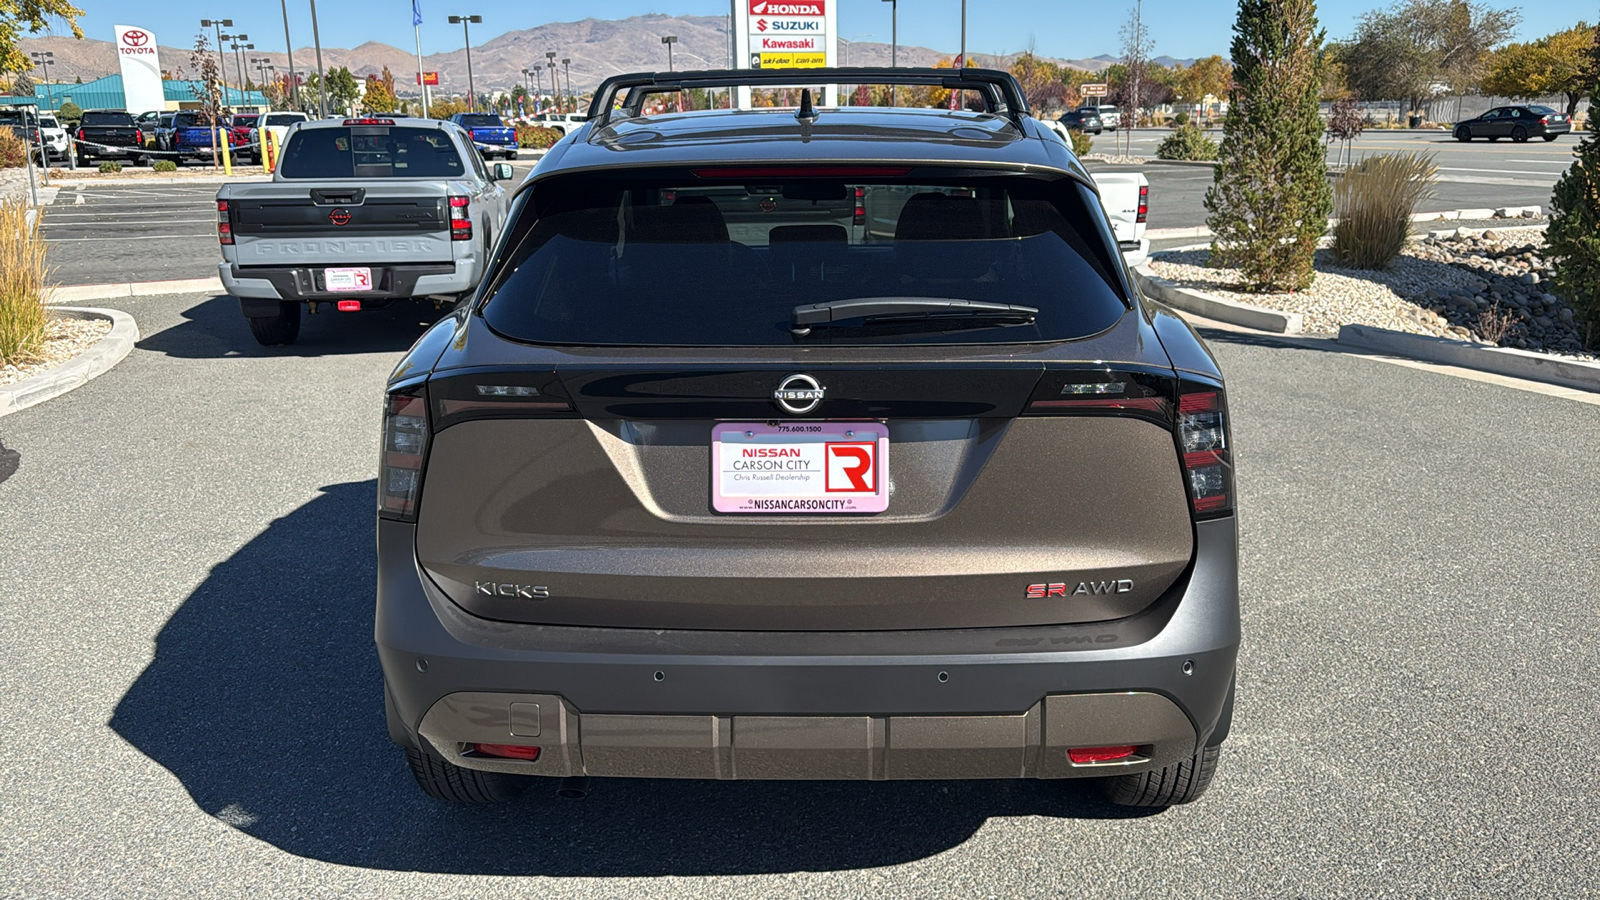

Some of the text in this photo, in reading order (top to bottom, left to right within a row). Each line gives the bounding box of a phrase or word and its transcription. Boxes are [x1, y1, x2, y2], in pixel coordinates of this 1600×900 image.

[767, 5, 821, 14] HONDA
[772, 21, 818, 30] SUZUKI
[763, 38, 814, 48] Kawasaki
[120, 47, 155, 55] TOYOTA
[256, 240, 433, 254] FRONTIER
[774, 391, 824, 399] NISSAN
[742, 448, 801, 458] NISSAN
[733, 460, 811, 471] CARSON CITY
[734, 473, 811, 482] Chris Russell Dealership
[475, 580, 550, 599] KICKS
[1026, 578, 1134, 599] SR AWD
